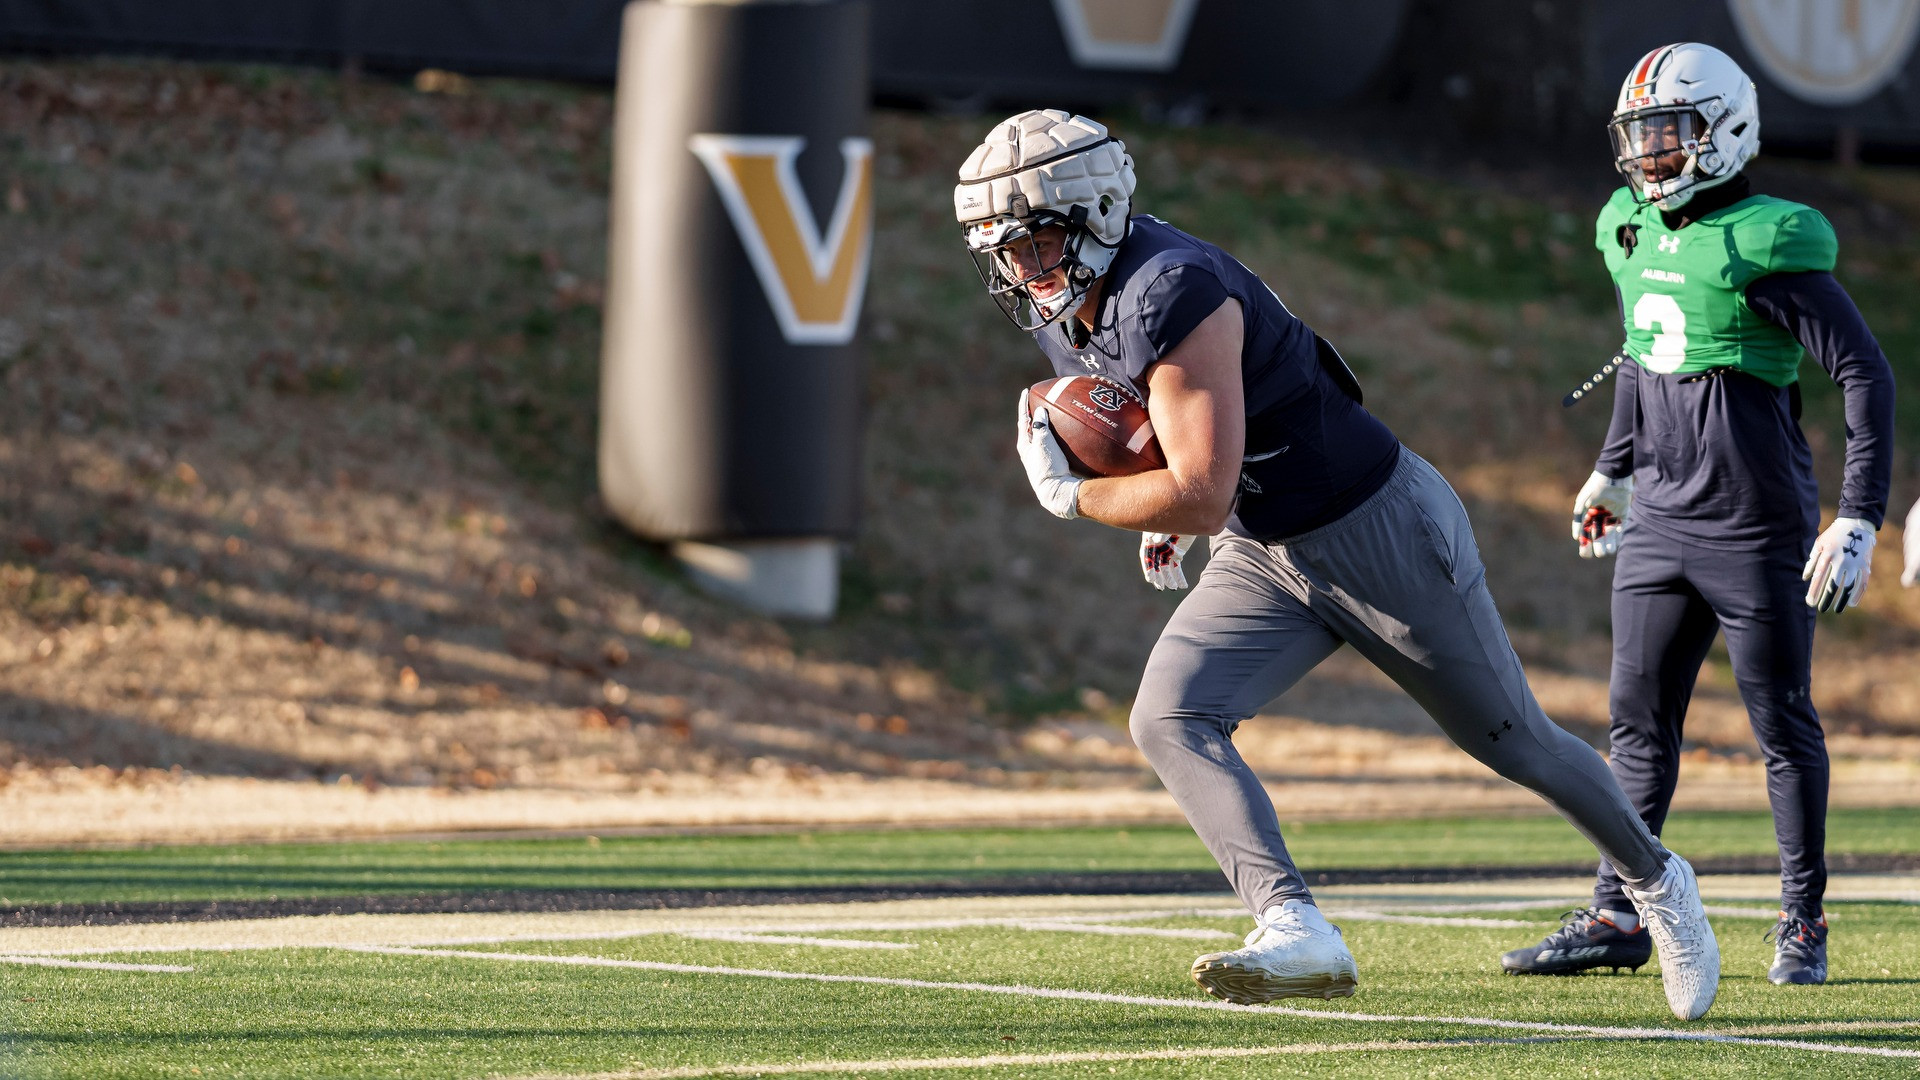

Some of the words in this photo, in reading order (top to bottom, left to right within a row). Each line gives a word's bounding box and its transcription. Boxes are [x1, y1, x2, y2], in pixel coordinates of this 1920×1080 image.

[690, 134, 873, 344] V
[1640, 268, 1685, 284] AUBURN
[1633, 292, 1688, 375] 3
[1071, 398, 1095, 414] TEAM
[1093, 412, 1119, 429] ISSUE
